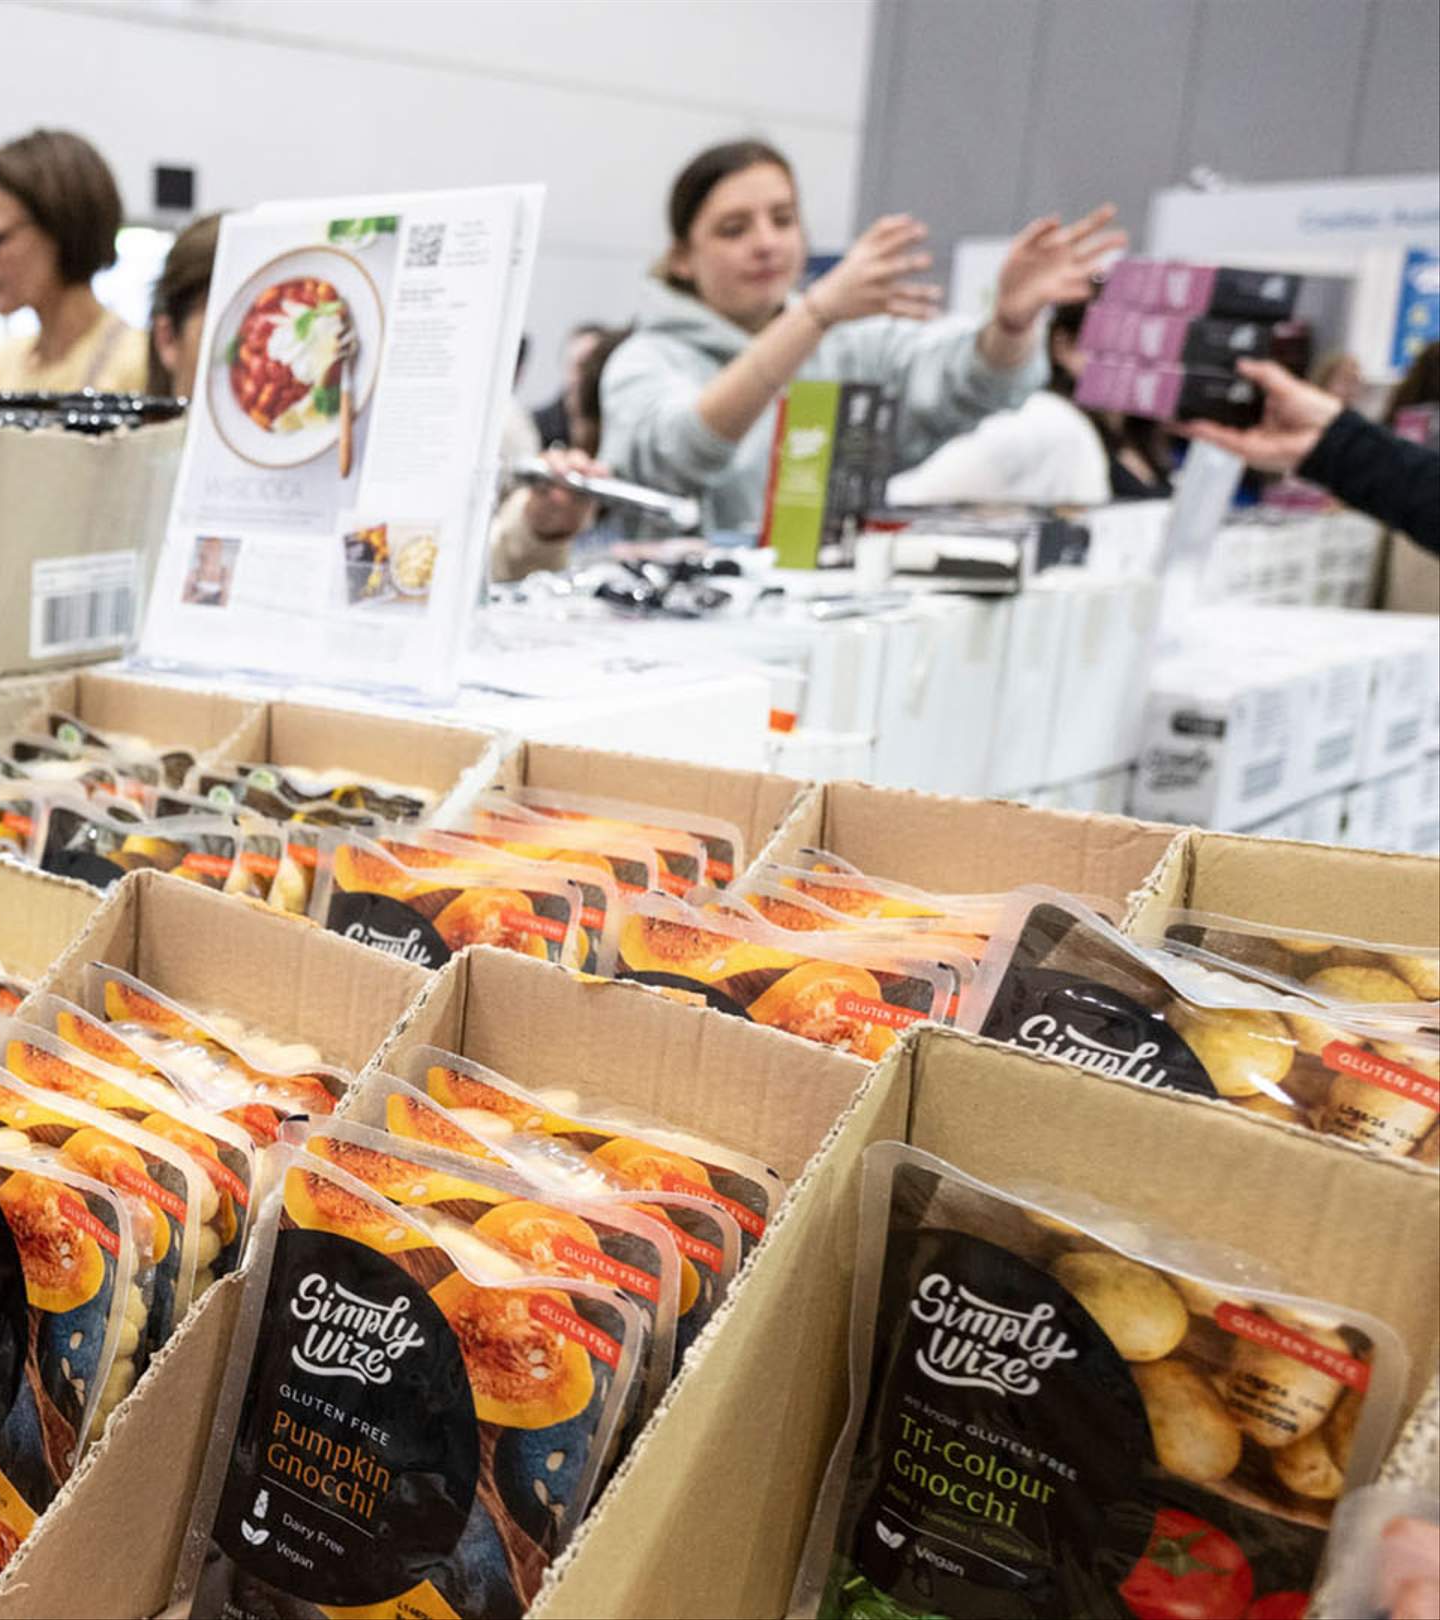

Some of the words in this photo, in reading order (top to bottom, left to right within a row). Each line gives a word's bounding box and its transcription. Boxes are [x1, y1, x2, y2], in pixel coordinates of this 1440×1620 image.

[844, 998, 891, 1022] GLUTEN
[1337, 1051, 1409, 1088] GLUTEN
[563, 1244, 617, 1281] GLUTEN
[619, 1267, 653, 1293] FREE
[289, 1272, 425, 1360] Simply
[538, 1302, 587, 1340] GLUTEN
[587, 1330, 616, 1359] FREE
[910, 1272, 1078, 1362] Simply
[1229, 1314, 1307, 1355] GLUTEN
[1311, 1349, 1358, 1380] FREE
[291, 1322, 393, 1385] Wize
[915, 1326, 1041, 1397] Wize
[278, 1382, 347, 1424] GLUTEN
[350, 1413, 392, 1447] FREE
[266, 1441, 376, 1520] Gnocchi
[271, 1408, 393, 1493] Pumpkin
[899, 1412, 1057, 1505] Tri-Colour
[964, 1423, 1034, 1459] GLUTEN
[1037, 1451, 1078, 1482] FREE
[893, 1448, 1019, 1528] Gnocchi
[275, 1539, 315, 1572] Vegan
[281, 1510, 316, 1546] Dairy
[316, 1527, 346, 1557] Free
[914, 1543, 965, 1577] Vegan
